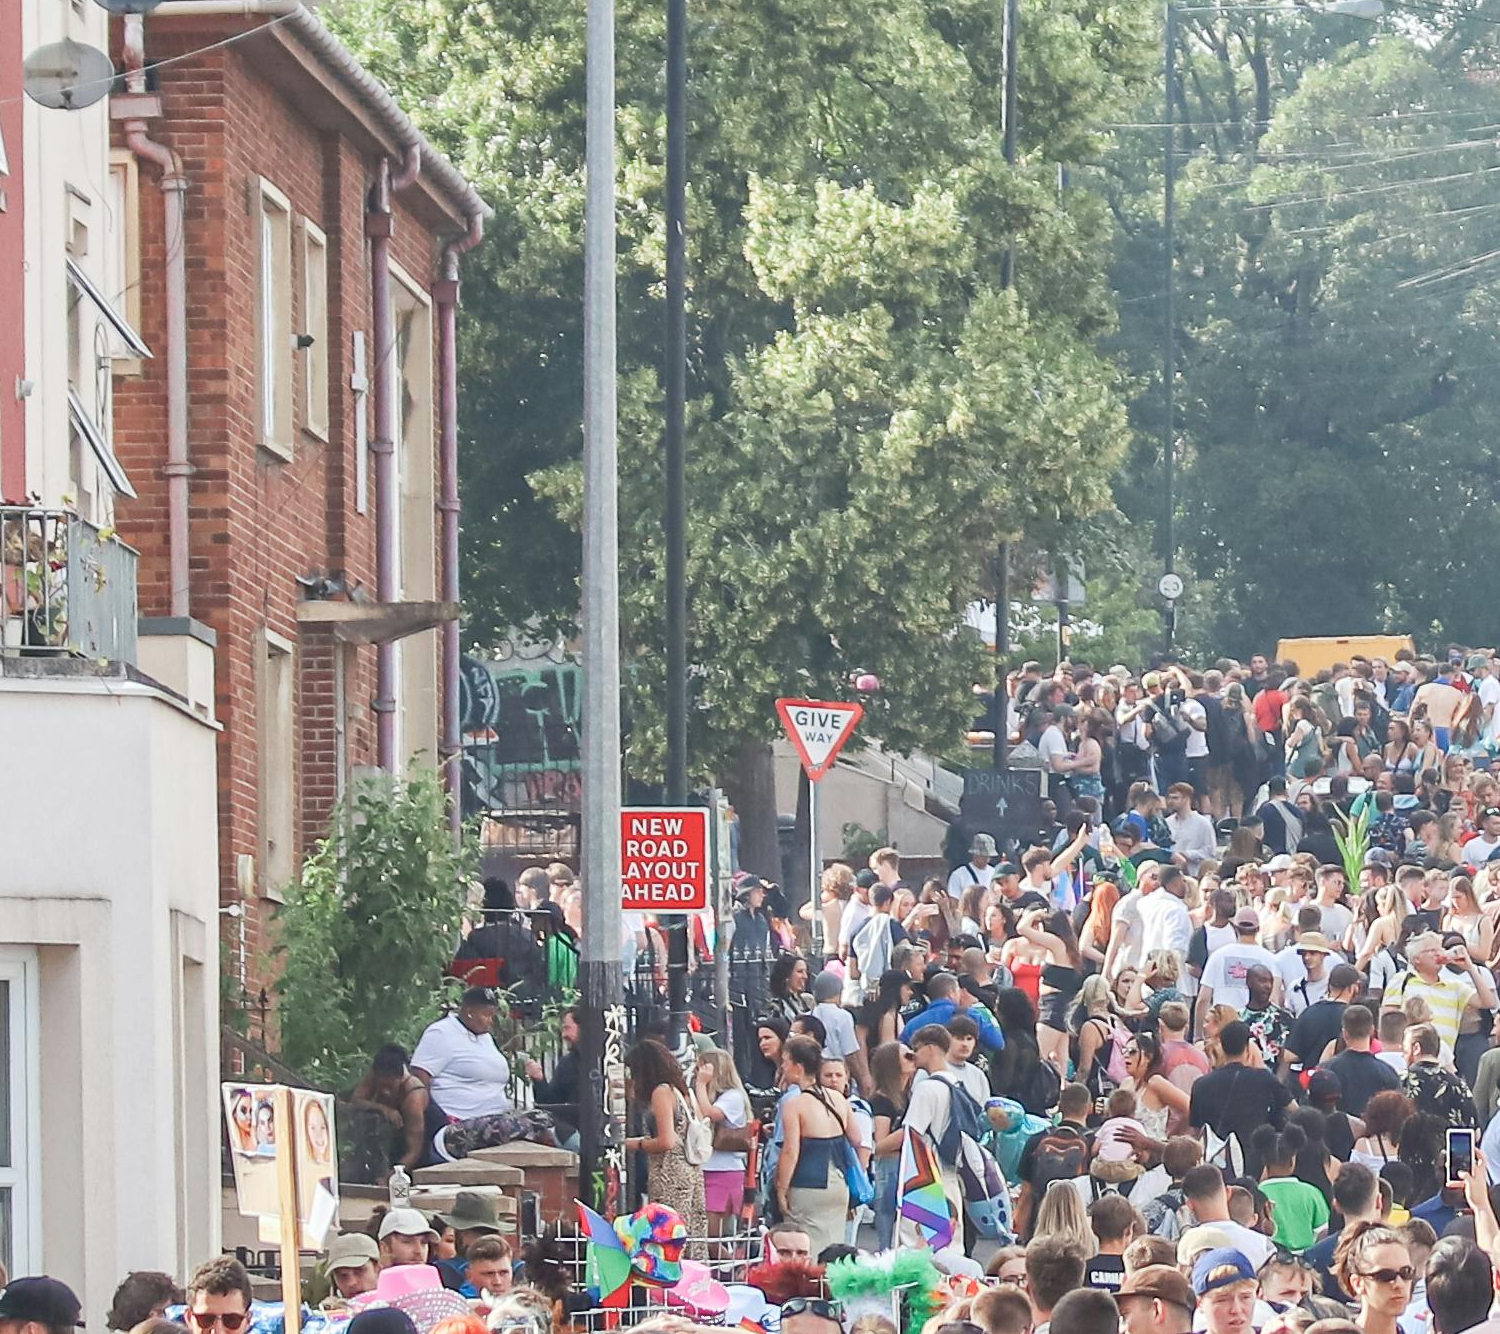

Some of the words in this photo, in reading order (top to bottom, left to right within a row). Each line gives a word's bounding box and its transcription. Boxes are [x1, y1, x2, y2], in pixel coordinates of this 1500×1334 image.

[795, 711, 841, 730] GIVE
[804, 732, 834, 744] WAY
[967, 775, 1037, 796] DRINKS
[631, 818, 682, 836] NEW
[626, 840, 688, 858] ROAD
[622, 882, 695, 902] AHEAD
